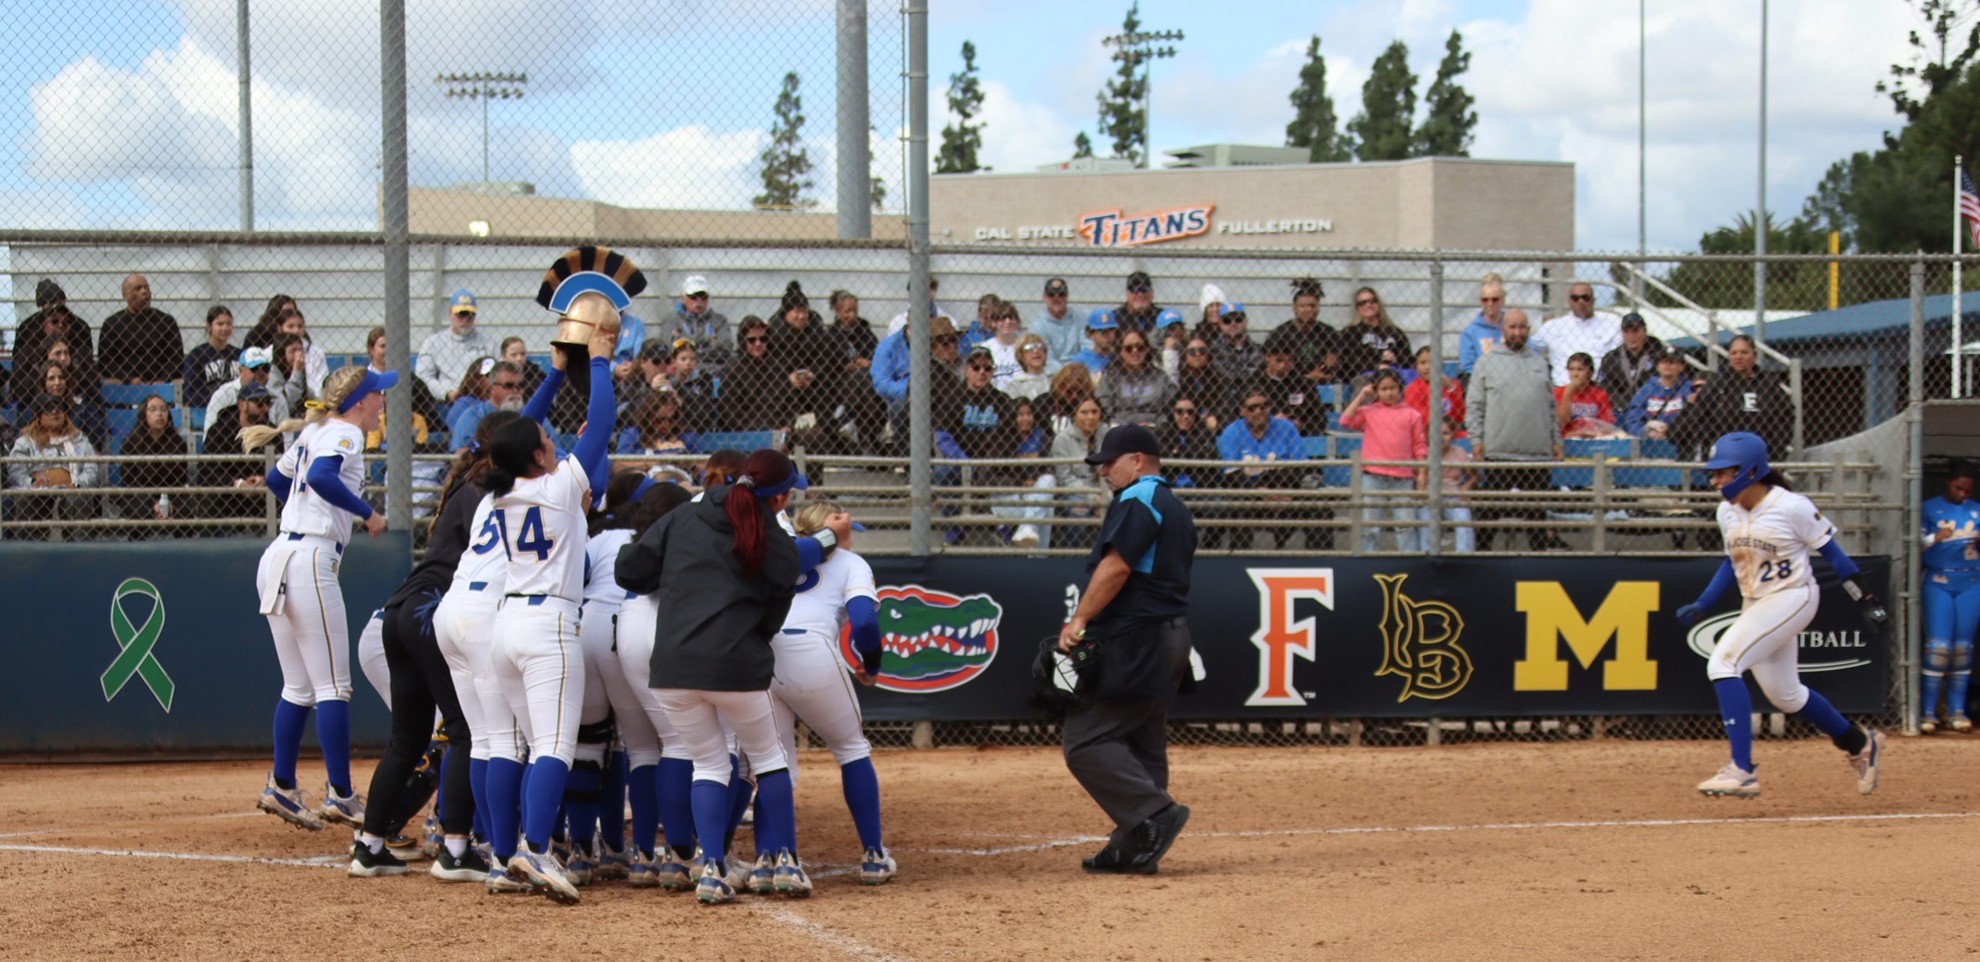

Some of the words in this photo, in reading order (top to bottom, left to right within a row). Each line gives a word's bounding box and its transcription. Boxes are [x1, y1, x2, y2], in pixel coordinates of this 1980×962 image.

[975, 226, 1012, 240] CAL
[1017, 224, 1075, 240] STATE
[1083, 207, 1206, 247] TITANS
[1217, 218, 1333, 235] FULLERTON
[494, 504, 554, 563] 14
[1759, 559, 1793, 582] 28
[1244, 567, 1334, 706] F
[1513, 581, 1660, 691] M
